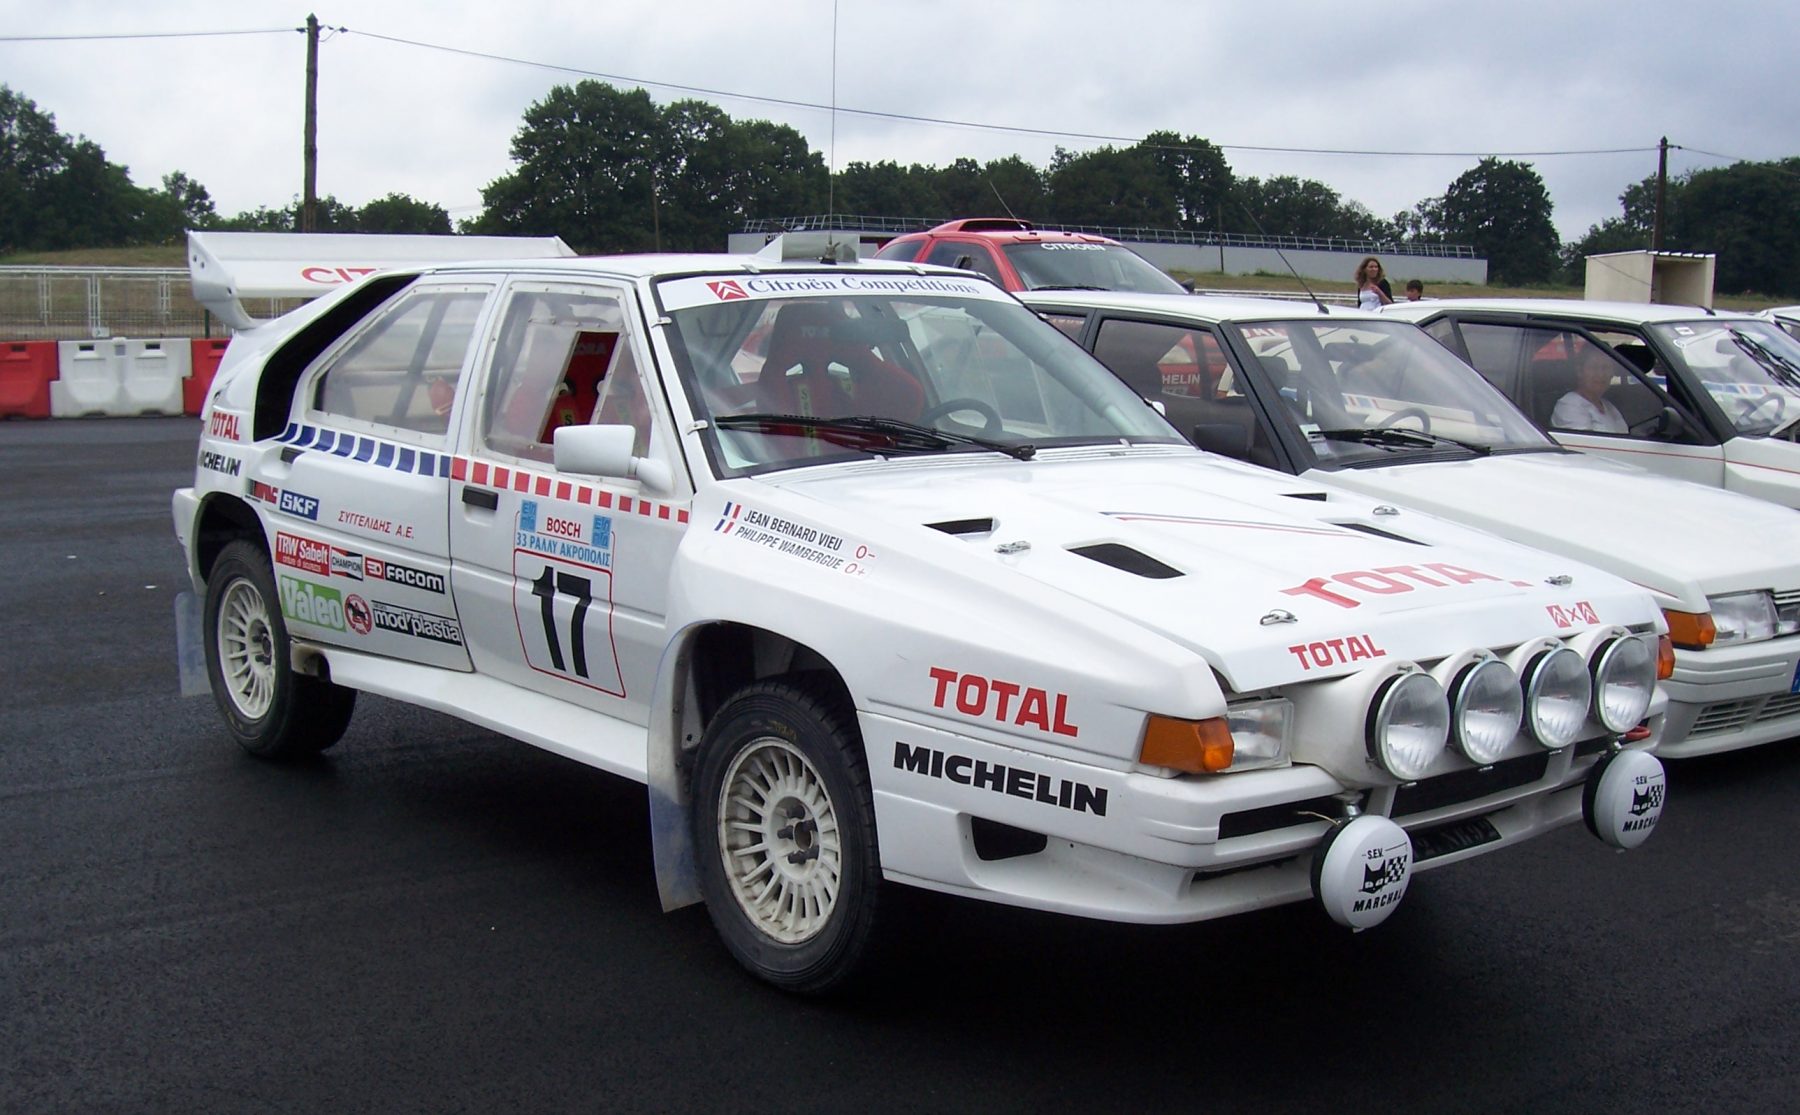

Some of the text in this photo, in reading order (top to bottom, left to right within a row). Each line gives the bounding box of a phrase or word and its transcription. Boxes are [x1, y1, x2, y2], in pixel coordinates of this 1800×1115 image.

[302, 267, 378, 283] CIT
[747, 277, 980, 293] Citroën Compétitions
[1161, 373, 1200, 385] HELIN
[210, 411, 241, 442] TOTAL
[282, 493, 318, 515] SKF
[516, 532, 528, 548] 33
[546, 516, 582, 539] BOSCH
[744, 510, 771, 528] JEAN
[770, 517, 817, 543] BERNARD
[819, 532, 843, 551] VIEU
[277, 534, 299, 557] TRW
[299, 540, 329, 565] Sabelt
[735, 525, 780, 549] PHILIPPE
[778, 539, 844, 570] WAMBERGUE
[332, 556, 362, 572] CHAMPION
[386, 565, 444, 592] FACOM
[1279, 562, 1535, 609] TOTA
[281, 577, 344, 630] Valeo
[531, 565, 593, 680] 17
[1288, 634, 1386, 671] TOTAL
[929, 667, 1079, 738] TOTAL
[893, 741, 1108, 817] MICHELIN
